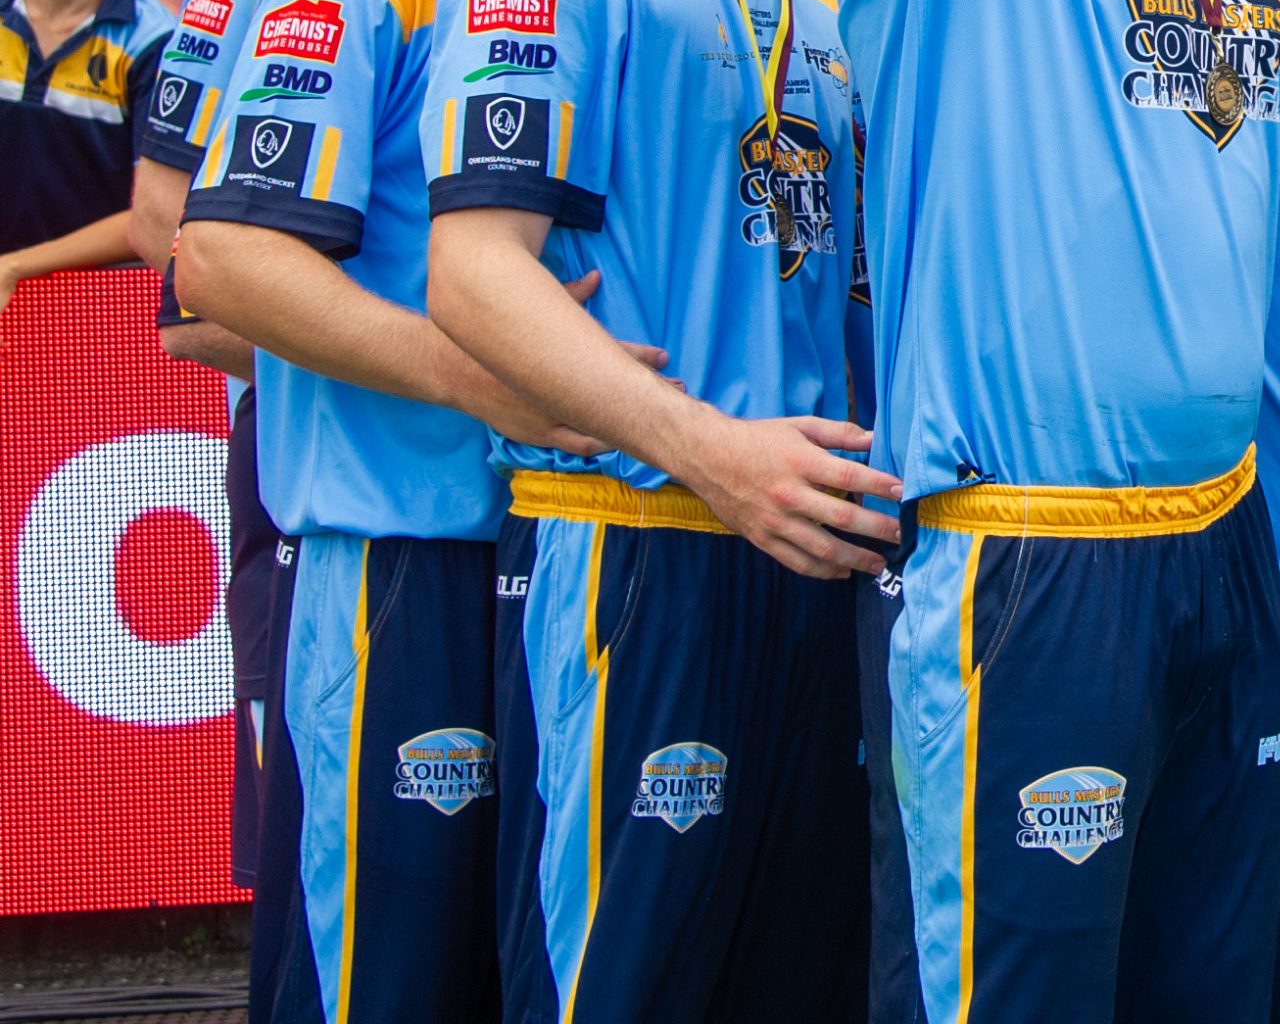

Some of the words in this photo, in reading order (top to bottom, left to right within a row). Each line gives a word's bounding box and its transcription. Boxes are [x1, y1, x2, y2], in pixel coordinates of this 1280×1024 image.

[262, 17, 339, 44] CHEMIST
[473, 11, 550, 27] WAREHOUSE
[177, 32, 220, 62] BMD
[488, 39, 557, 69] BMD
[263, 63, 333, 94] BMD
[468, 156, 511, 166] QUEENSLAND
[511, 158, 541, 169] CRICKET
[487, 162, 518, 172] COUNTRY
[637, 775, 728, 799] COUNTRY
[1028, 791, 1070, 805] BULLS
[1018, 796, 1126, 828] COUNTRY
